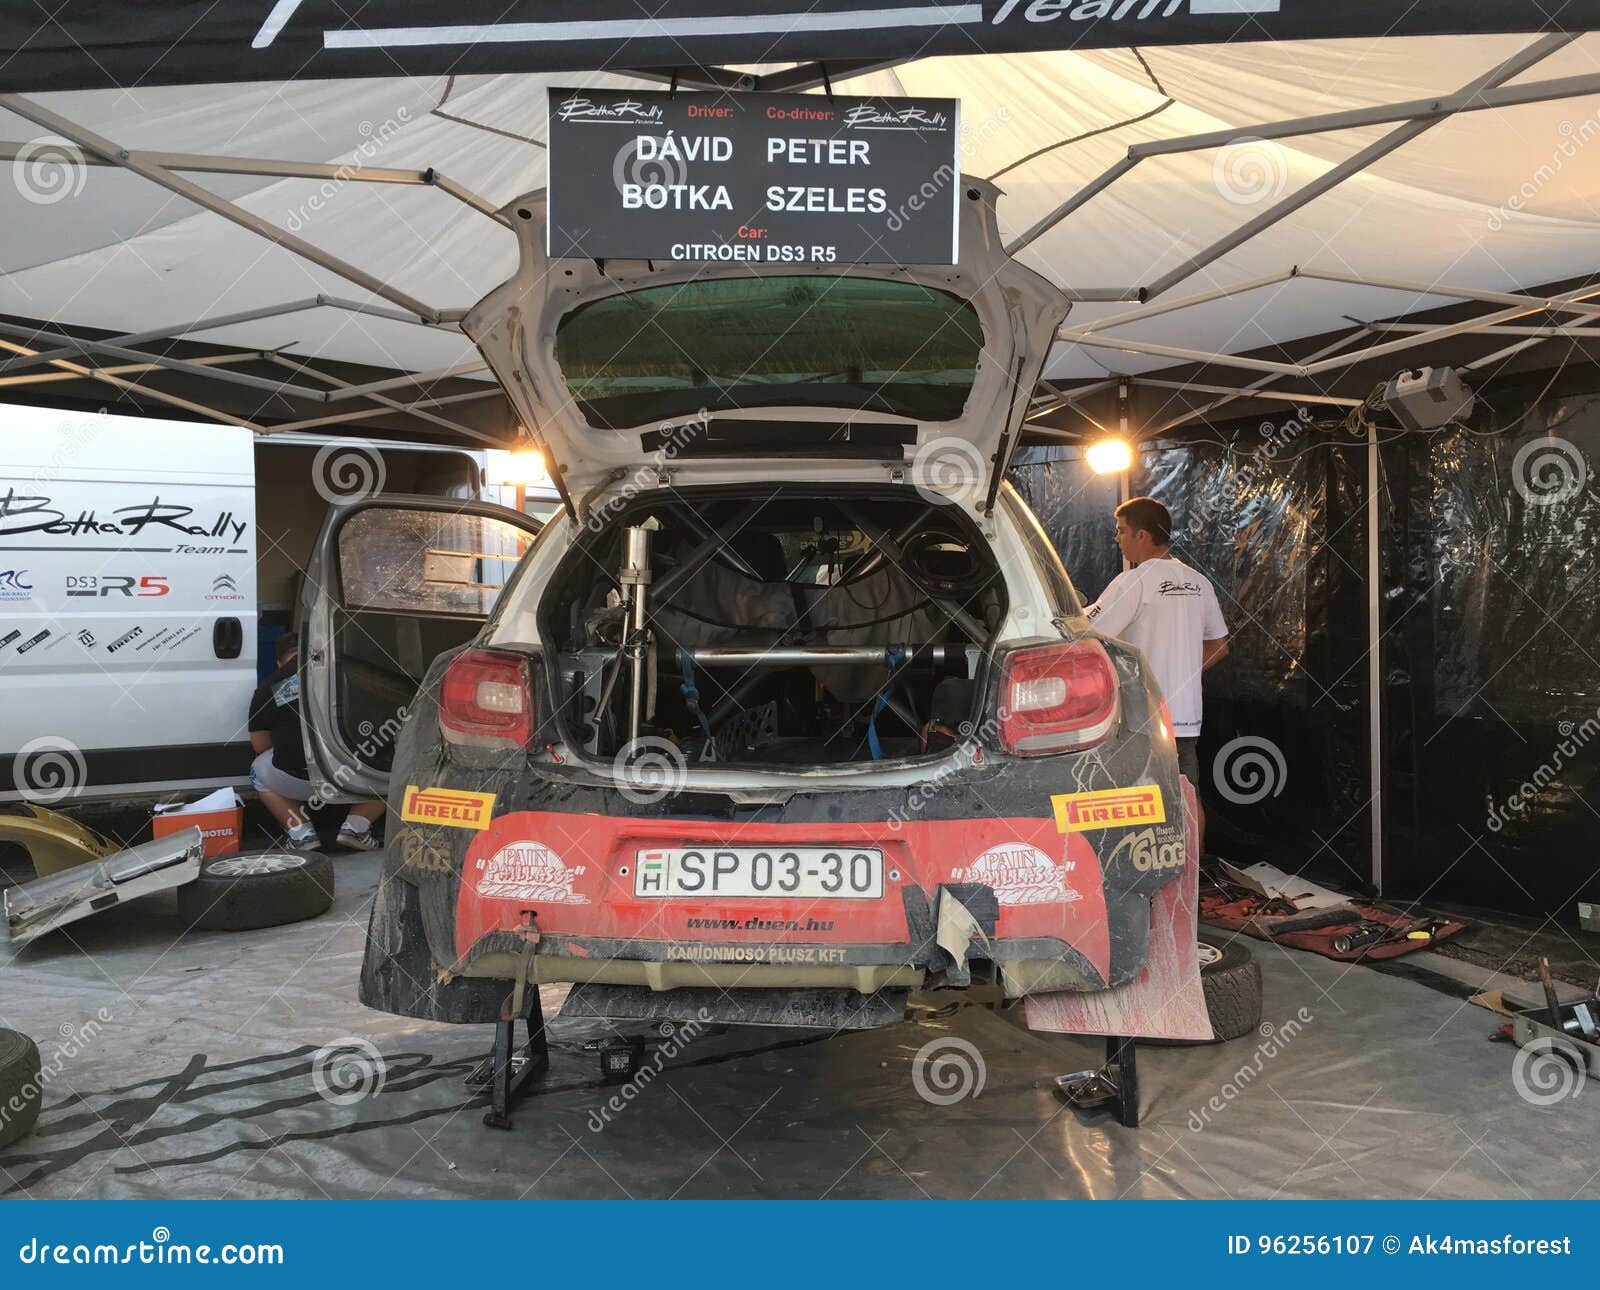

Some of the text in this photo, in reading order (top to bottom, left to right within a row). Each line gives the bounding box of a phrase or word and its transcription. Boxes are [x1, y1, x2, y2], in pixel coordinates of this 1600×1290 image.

[687, 104, 835, 121] Driver: Co-driver:
[636, 130, 871, 165] DÁVID PETER
[622, 184, 887, 213] BOTKA SZELES
[737, 225, 768, 239] Car:
[671, 244, 836, 262] CITROEN DS3 R5
[175, 545, 225, 555] Team
[66, 576, 169, 597] DS3 R5
[408, 792, 484, 822] PIRELLI
[1066, 793, 1154, 825] PIRELLI
[503, 848, 549, 866] PAIN
[984, 849, 1037, 871] PAIN
[643, 851, 872, 892] H SP 03-30
[687, 917, 835, 932] www.duen.hu
[768, 948, 815, 962] PLUSZ
[818, 949, 847, 962] KFT
